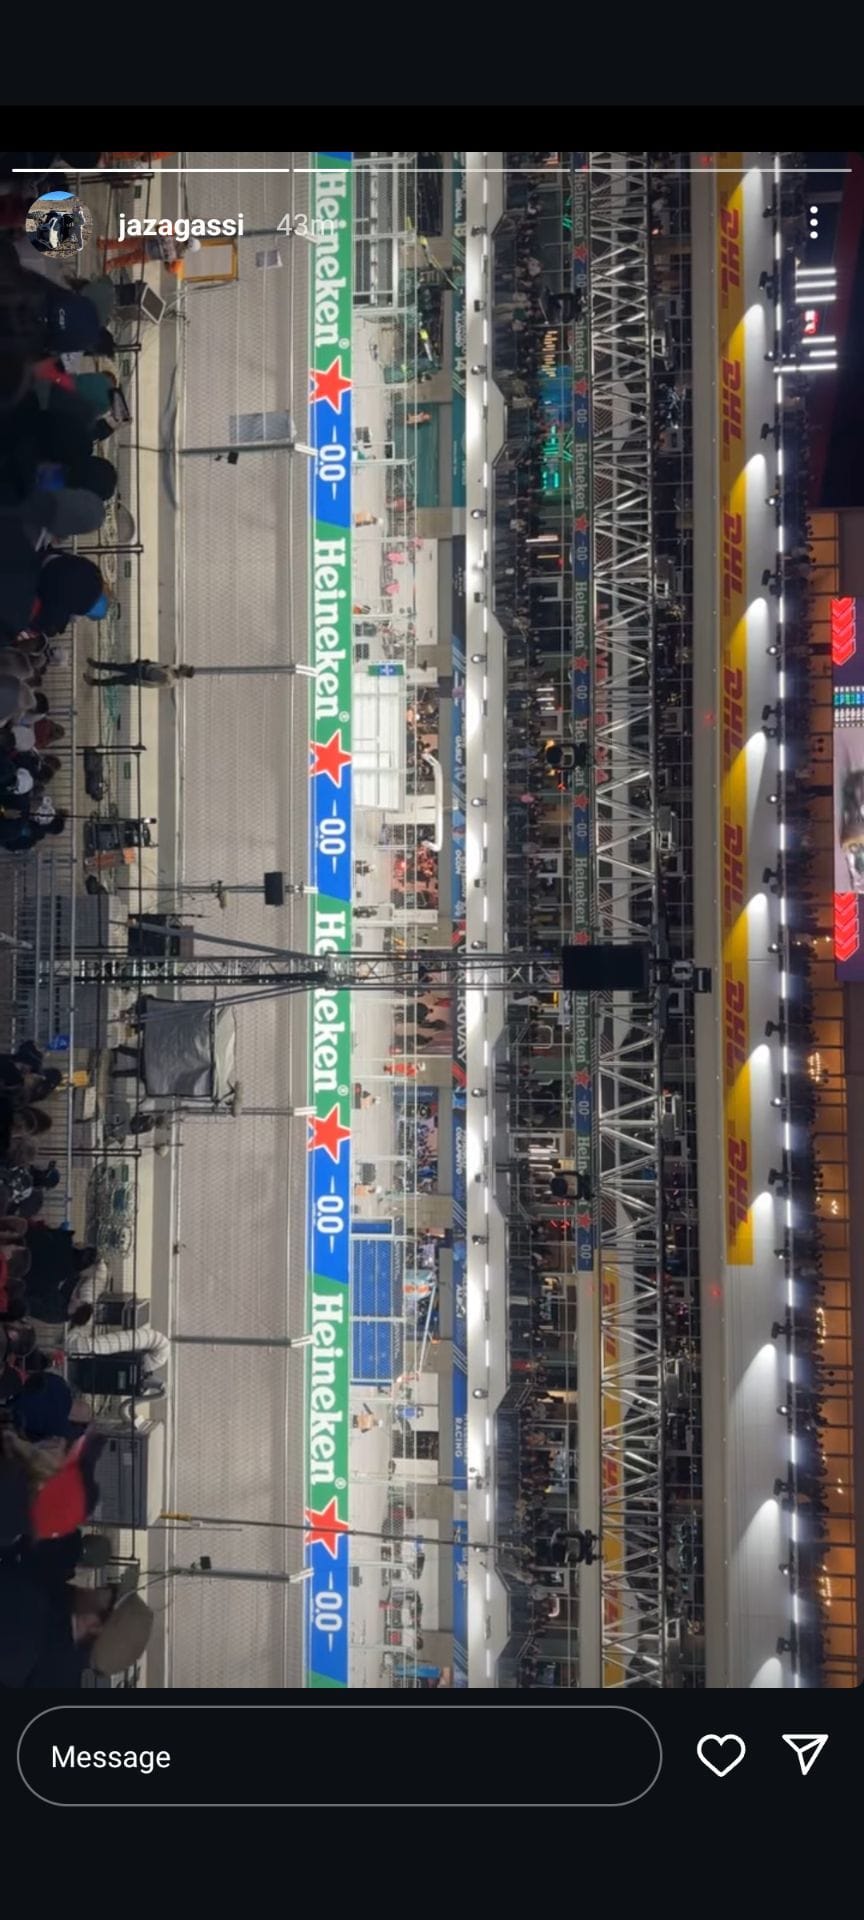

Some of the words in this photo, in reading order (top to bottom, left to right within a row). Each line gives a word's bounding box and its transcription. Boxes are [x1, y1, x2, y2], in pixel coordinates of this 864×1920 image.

[315, 172, 347, 347] Heineken
[720, 208, 739, 293] DHL
[574, 319, 588, 372] eineken
[722, 359, 741, 443] DHL
[318, 444, 346, 482] 0.0
[574, 443, 588, 510] Heineken
[724, 511, 743, 600] DHL
[314, 538, 347, 720] Heineken
[574, 581, 588, 648] Heineken
[724, 665, 743, 755] DHL
[574, 720, 588, 787] Heien
[319, 818, 346, 854] 0.0
[723, 822, 743, 911] DHL
[575, 857, 588, 925] Heineken
[314, 911, 347, 1093] Heeken
[575, 996, 589, 1063] Heineken
[725, 979, 745, 1069] DHL
[316, 1195, 344, 1234] 0.0
[728, 1137, 748, 1228] DHL
[311, 1293, 344, 1486] Heineken
[315, 1591, 343, 1632] 0.0
